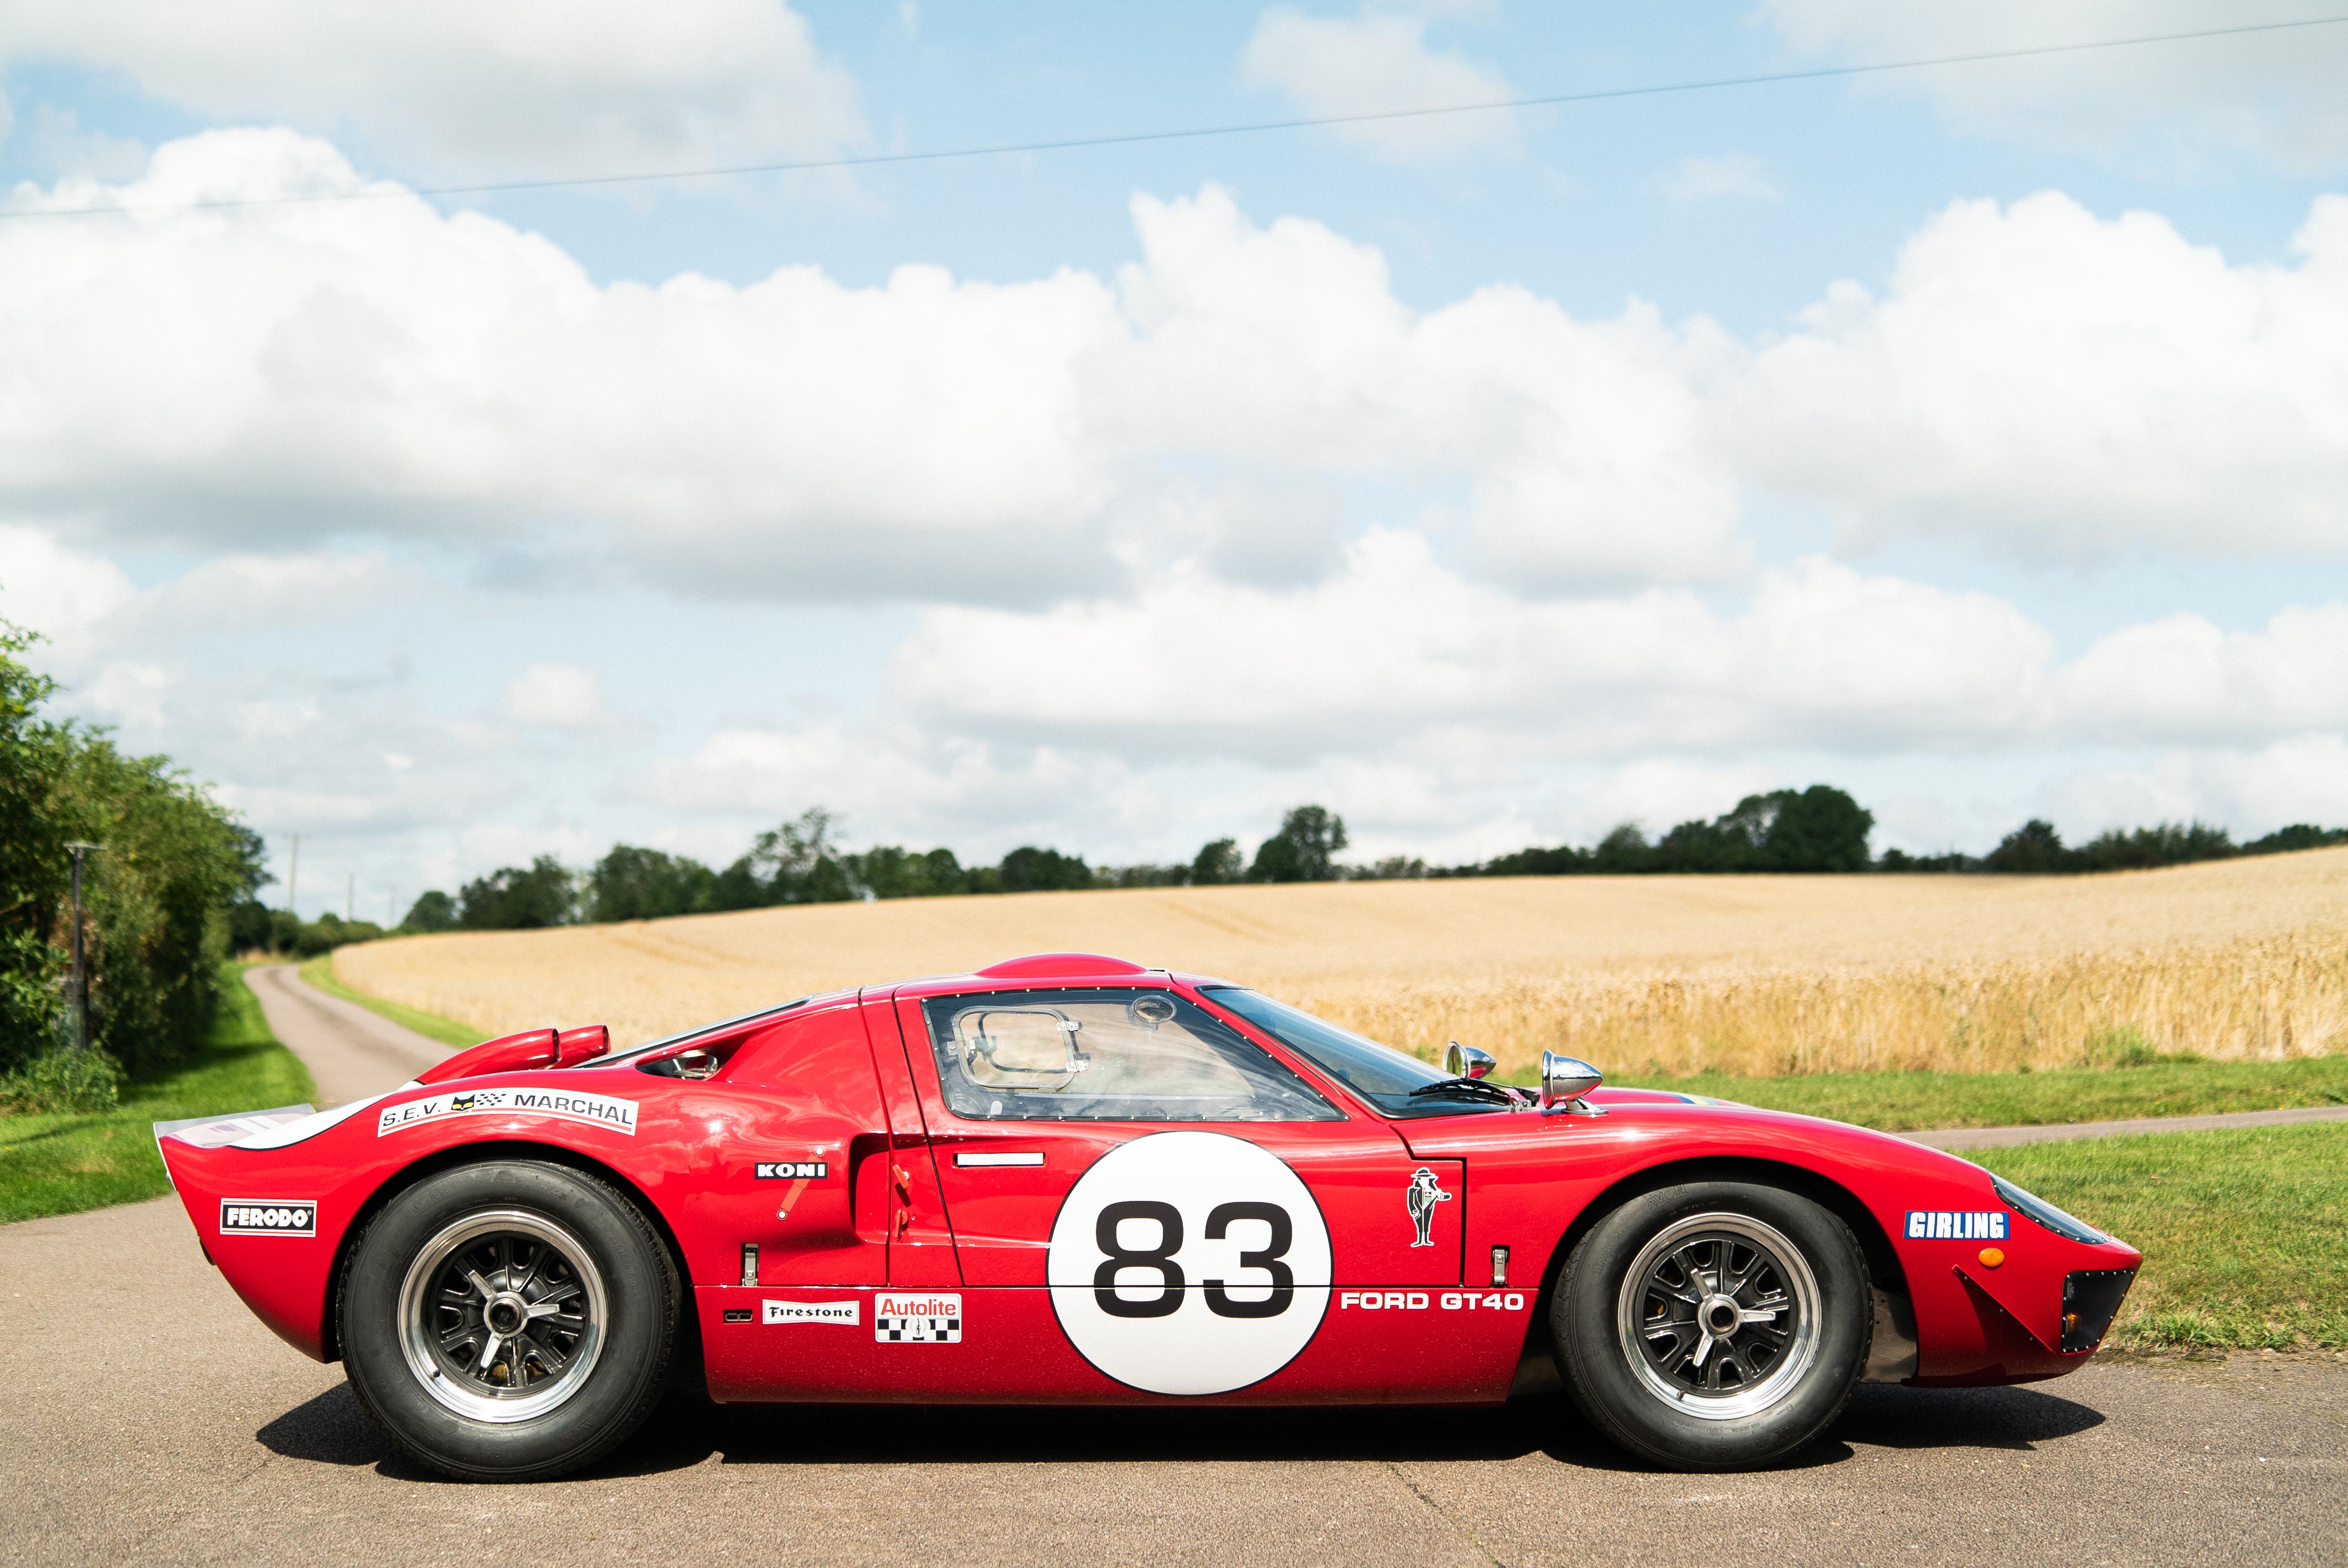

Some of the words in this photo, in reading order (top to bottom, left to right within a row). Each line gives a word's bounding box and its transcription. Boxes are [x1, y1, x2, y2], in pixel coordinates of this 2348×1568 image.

[383, 1102, 441, 1127] S.E.V.
[514, 1094, 633, 1126] MARCHAL
[758, 1163, 825, 1177] KONI
[1647, 1184, 1688, 1210] AVON
[1909, 1212, 2004, 1239] GIRLING
[1093, 1200, 1294, 1319] 83
[769, 1307, 853, 1318] Firestone
[881, 1298, 956, 1316] Autolite
[1341, 1292, 1429, 1309] FORD
[1440, 1292, 1525, 1311] GT40
